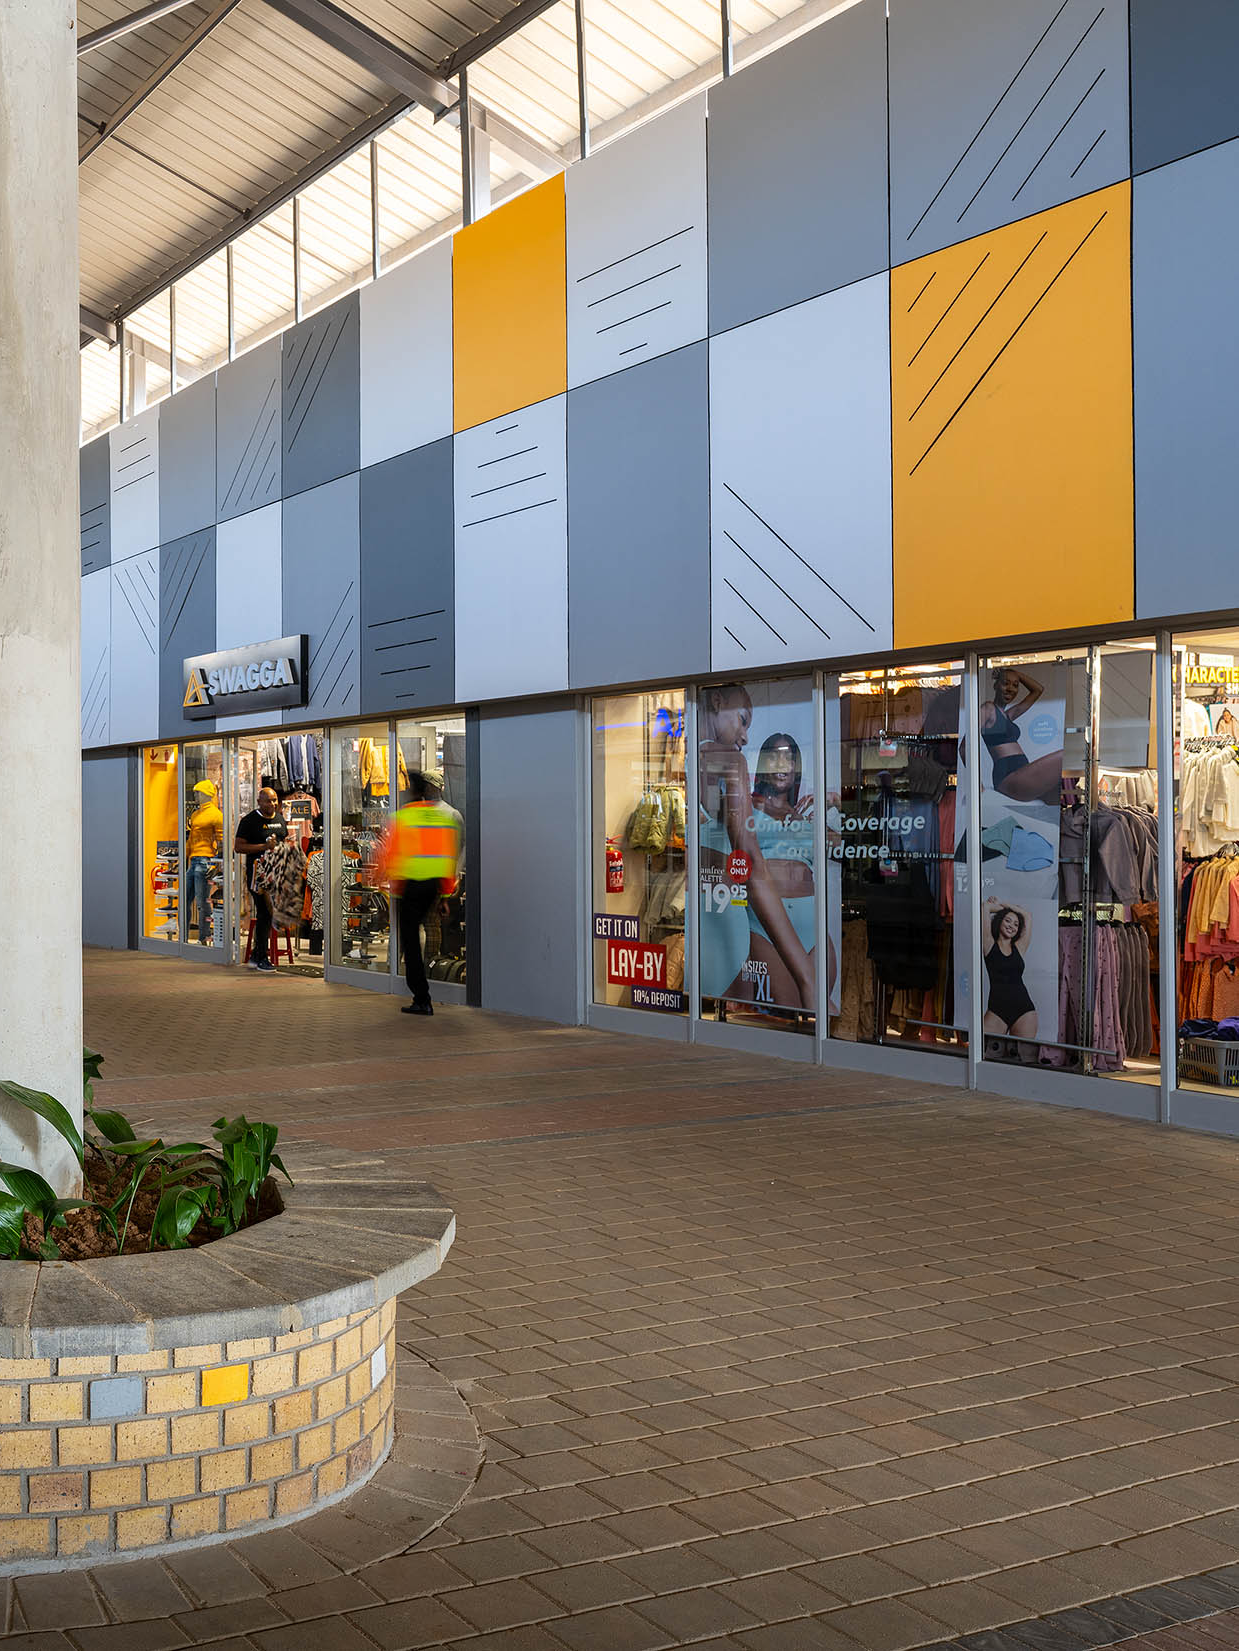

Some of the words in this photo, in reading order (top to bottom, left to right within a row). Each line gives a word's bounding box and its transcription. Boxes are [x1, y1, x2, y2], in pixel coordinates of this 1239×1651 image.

[208, 658, 294, 696] SWAGGA
[290, 805, 310, 815] ALE
[730, 867, 748, 875] ONLY
[732, 858, 746, 866] FOR
[730, 884, 748, 900] 95
[596, 917, 612, 936] GET
[614, 919, 623, 937] IT
[624, 920, 638, 938] ON
[610, 947, 664, 982] LAY-BY
[748, 960, 768, 975] SIZES
[756, 975, 775, 1002] XL
[633, 989, 650, 1004] 10%
[650, 991, 681, 1009] DEPOSIT
